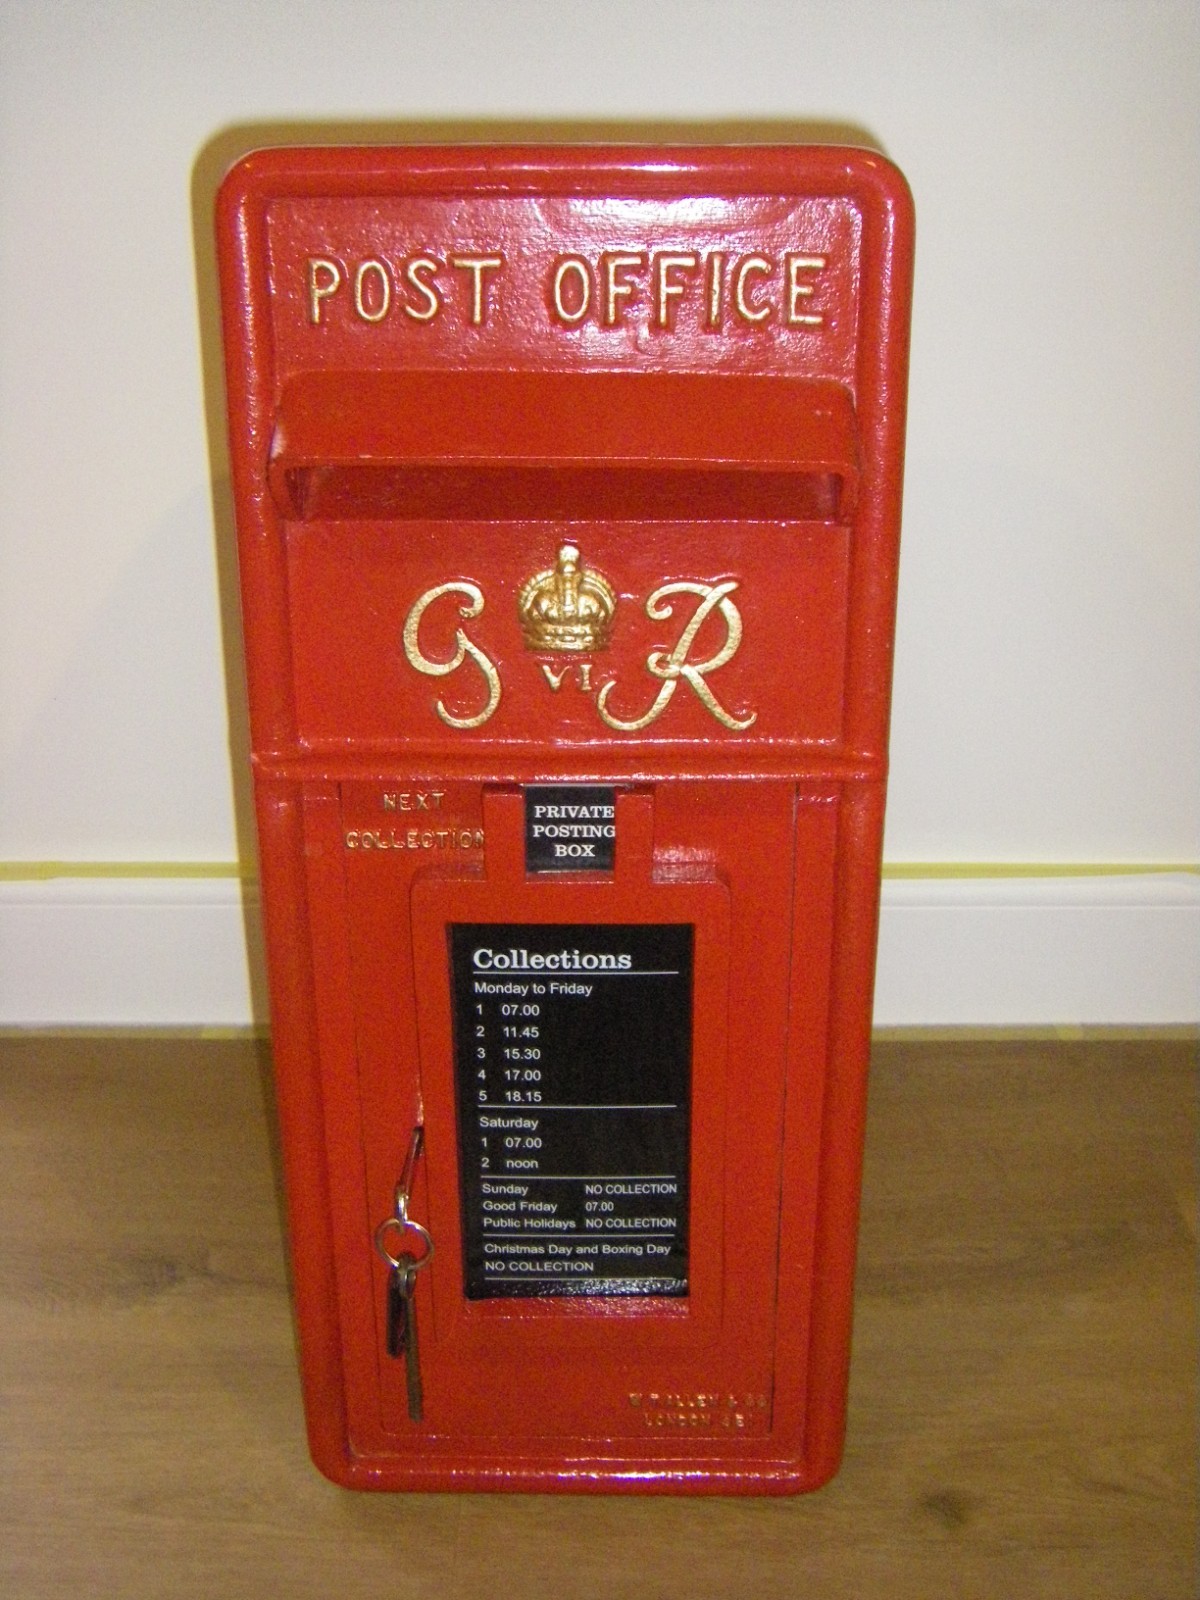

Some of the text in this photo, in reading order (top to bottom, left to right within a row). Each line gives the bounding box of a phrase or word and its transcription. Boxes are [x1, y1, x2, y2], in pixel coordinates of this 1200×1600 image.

[307, 257, 826, 326] POST OFFICE
[403, 580, 758, 732] G R
[540, 662, 594, 693] VI
[382, 791, 446, 812] NEXT
[533, 805, 615, 819] PRIVATE
[532, 823, 616, 838] POSTING
[553, 843, 596, 858] BOX
[472, 948, 633, 970] Collections
[474, 981, 593, 997] Monday to Friday
[476, 1003, 540, 1017] 1 07.00
[476, 1025, 540, 1038] 2 11.45
[477, 1047, 541, 1060] 3 15.30
[477, 1069, 542, 1082] 4 17.00
[478, 1090, 542, 1103] 5 18.15
[479, 1116, 539, 1131] Saturday
[481, 1136, 543, 1149] 1 07.00
[481, 1157, 539, 1169] 2 noon
[481, 1183, 678, 1197] Sunday NO COLLECTION
[482, 1200, 615, 1214] Good Friday 07.00
[483, 1217, 677, 1231] Public Holidays NO COLLECTION
[484, 1243, 672, 1256] Christmas Day and Boxing Day
[485, 1261, 594, 1272] NO COLLECTION
